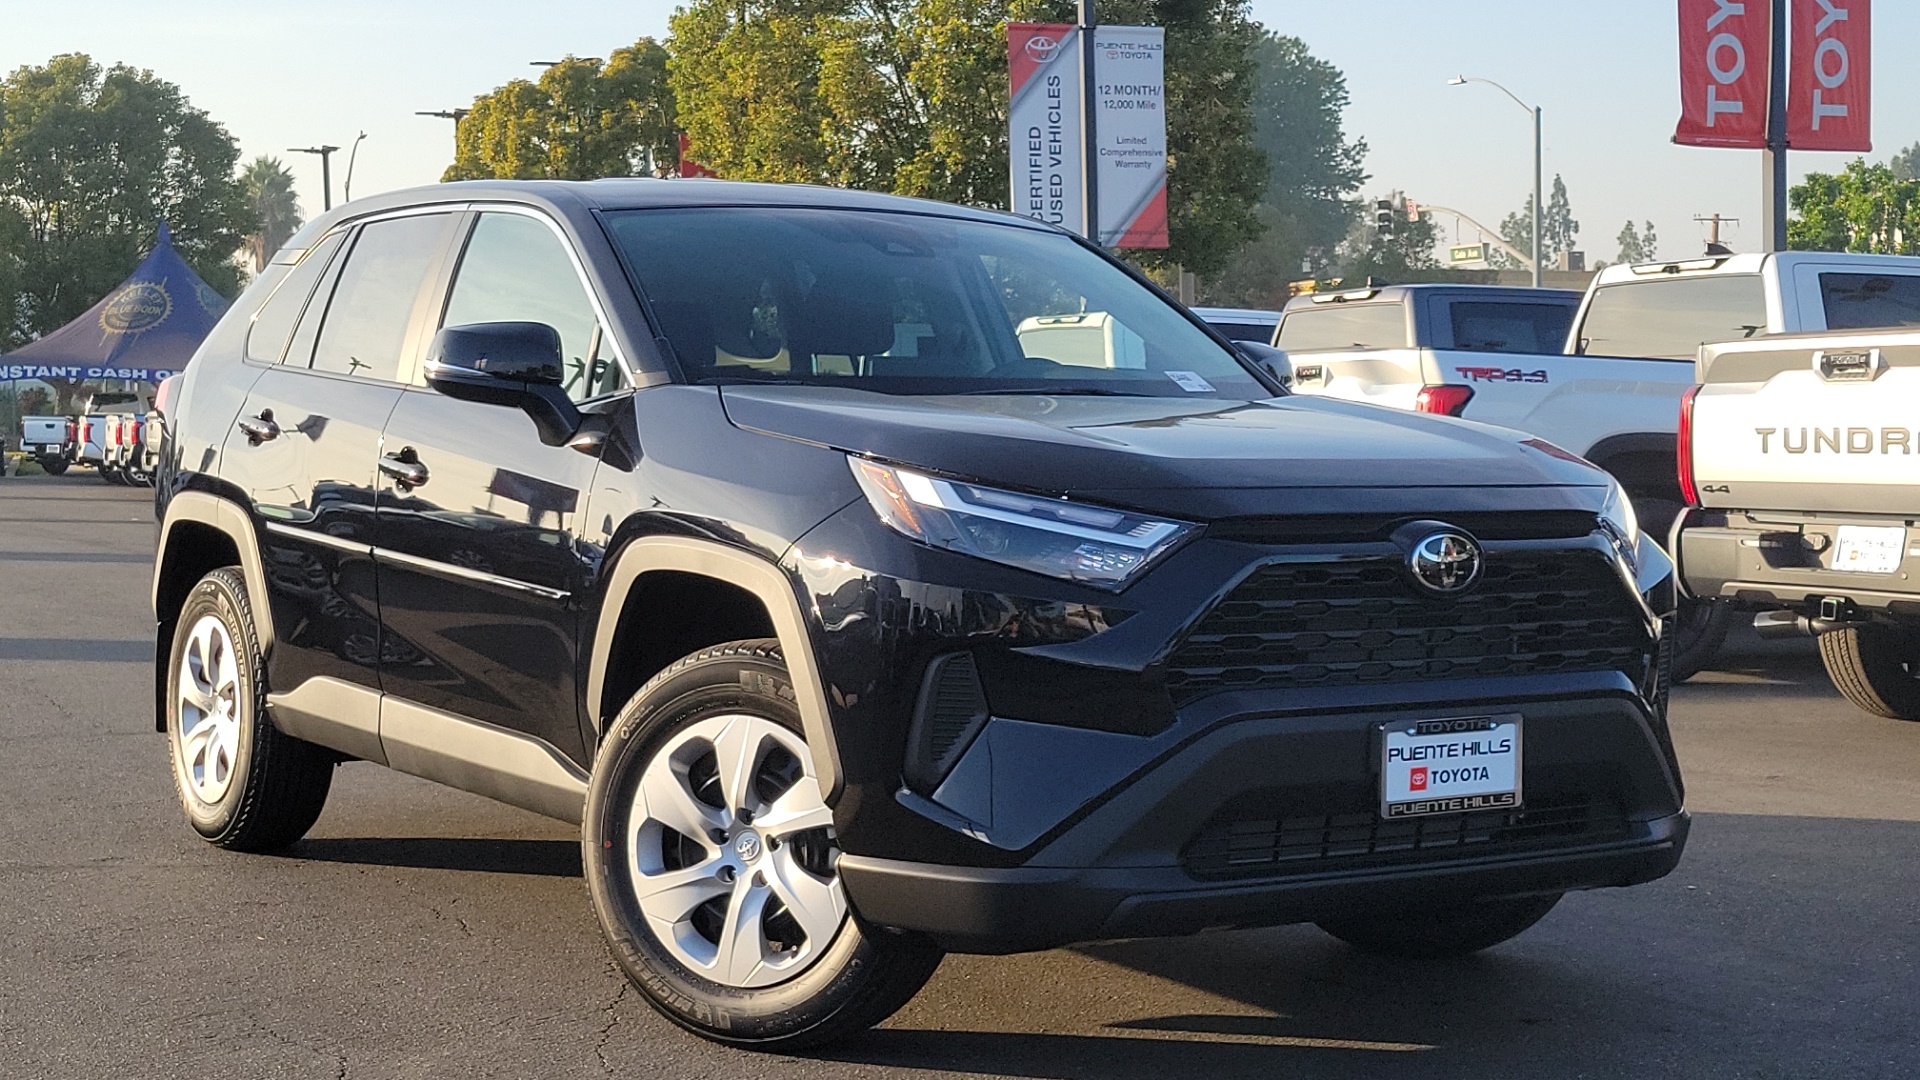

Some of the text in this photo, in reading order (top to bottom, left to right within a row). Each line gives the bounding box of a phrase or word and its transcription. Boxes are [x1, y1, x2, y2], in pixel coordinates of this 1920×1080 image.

[1706, 0, 1745, 127] TOY
[1812, 0, 1849, 130] TOY
[1098, 85, 1161, 96] 12 MONTH/
[1104, 100, 1156, 110] 12,000 Mile
[1116, 136, 1147, 144] Limited
[1048, 75, 1063, 224] USED VEHICLES
[1100, 148, 1163, 159] Comprehensive
[1029, 126, 1043, 220] CERTIFIED
[1115, 160, 1152, 169] Warranty
[88, 367, 147, 379] CASH
[1755, 427, 1920, 455] TUNDR
[1418, 719, 1489, 733] TOYOTA
[1388, 739, 1511, 763] PUENTE HILLS
[1431, 766, 1489, 784] TOYOTA
[1390, 794, 1514, 815] PUENTE HILLS
